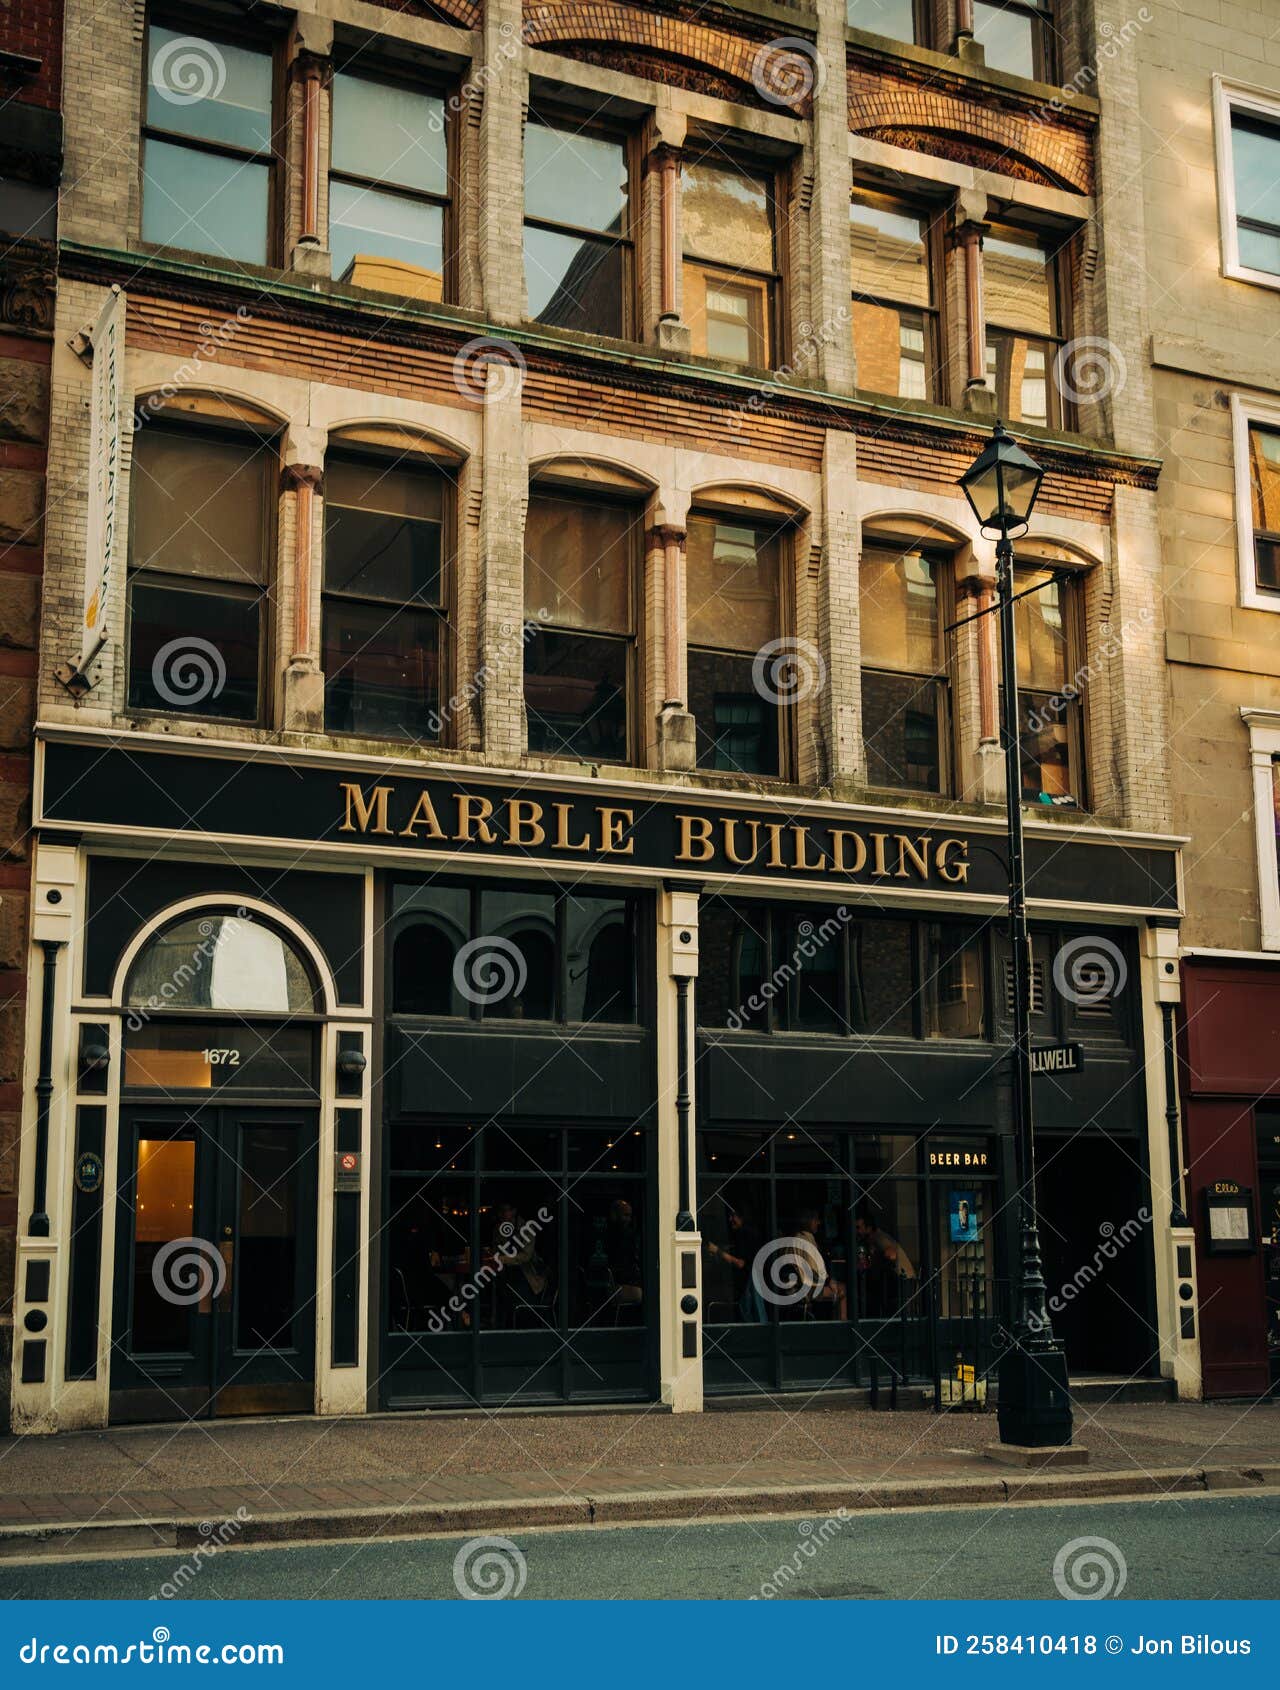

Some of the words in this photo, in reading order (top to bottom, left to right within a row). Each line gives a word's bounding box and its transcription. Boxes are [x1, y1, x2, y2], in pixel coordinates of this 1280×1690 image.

[100, 436, 116, 618] NATIONAL
[338, 782, 635, 855] MARBLE
[674, 814, 971, 884] BUILDING
[201, 1048, 240, 1065] 1672
[1029, 1048, 1077, 1072] ILLWELL
[930, 1153, 960, 1165] BEER
[964, 1153, 987, 1165] BAR
